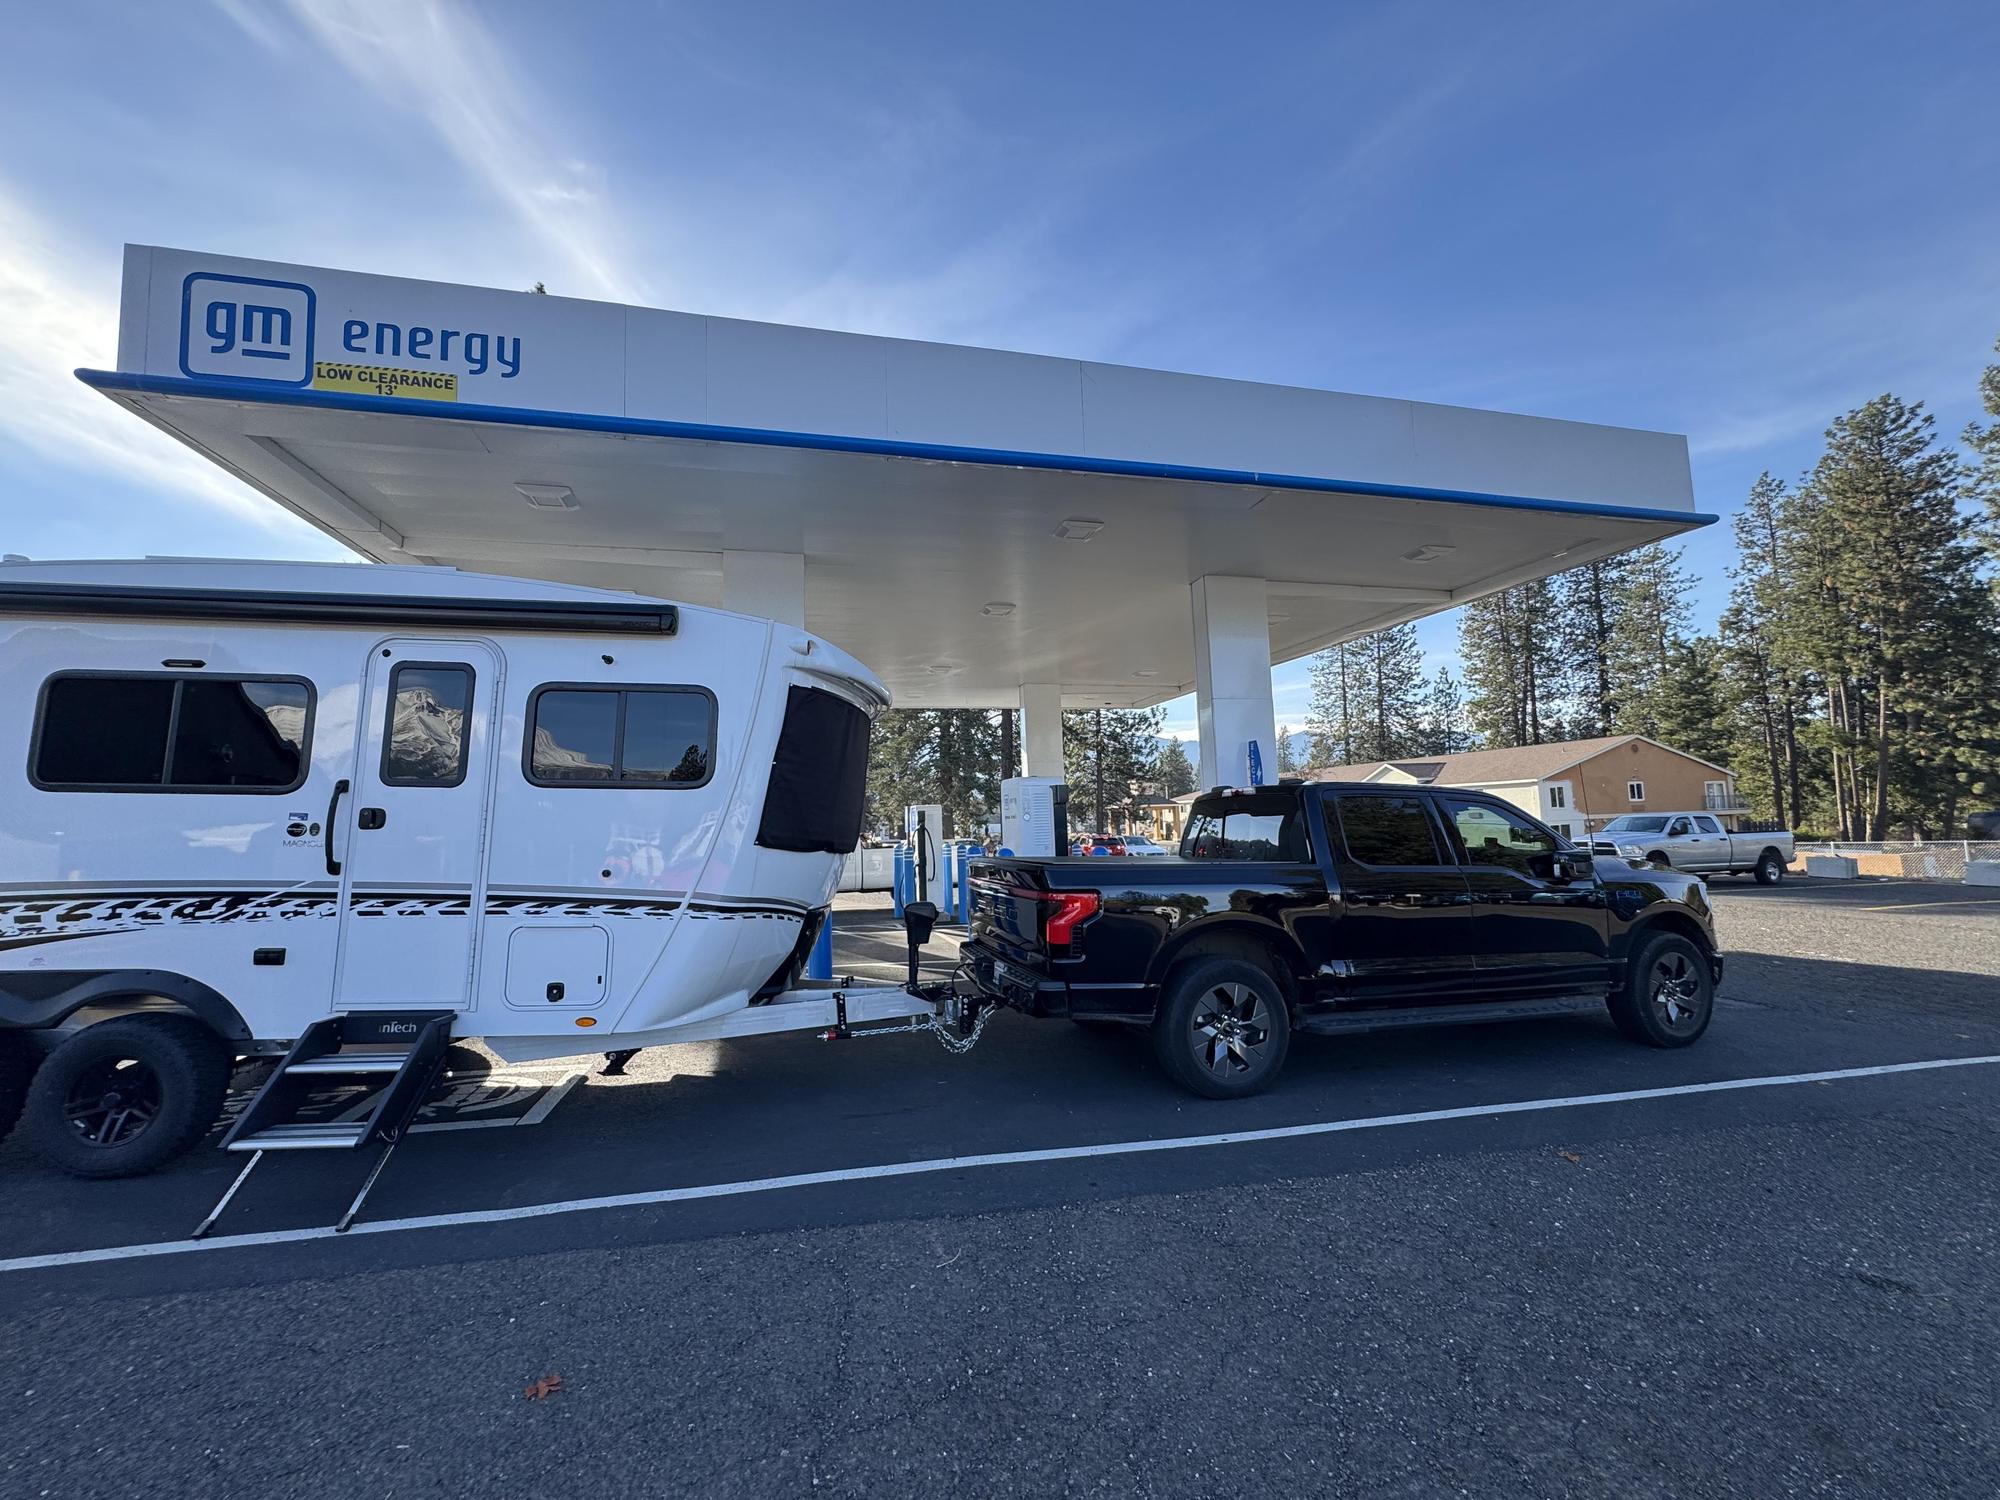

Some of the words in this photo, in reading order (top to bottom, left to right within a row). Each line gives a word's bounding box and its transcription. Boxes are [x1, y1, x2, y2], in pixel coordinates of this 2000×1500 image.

[206, 301, 292, 360] gm
[343, 320, 521, 378] energy
[317, 367, 352, 381] LOW
[358, 371, 453, 390] CLEARANCE
[375, 384, 398, 396] 13'
